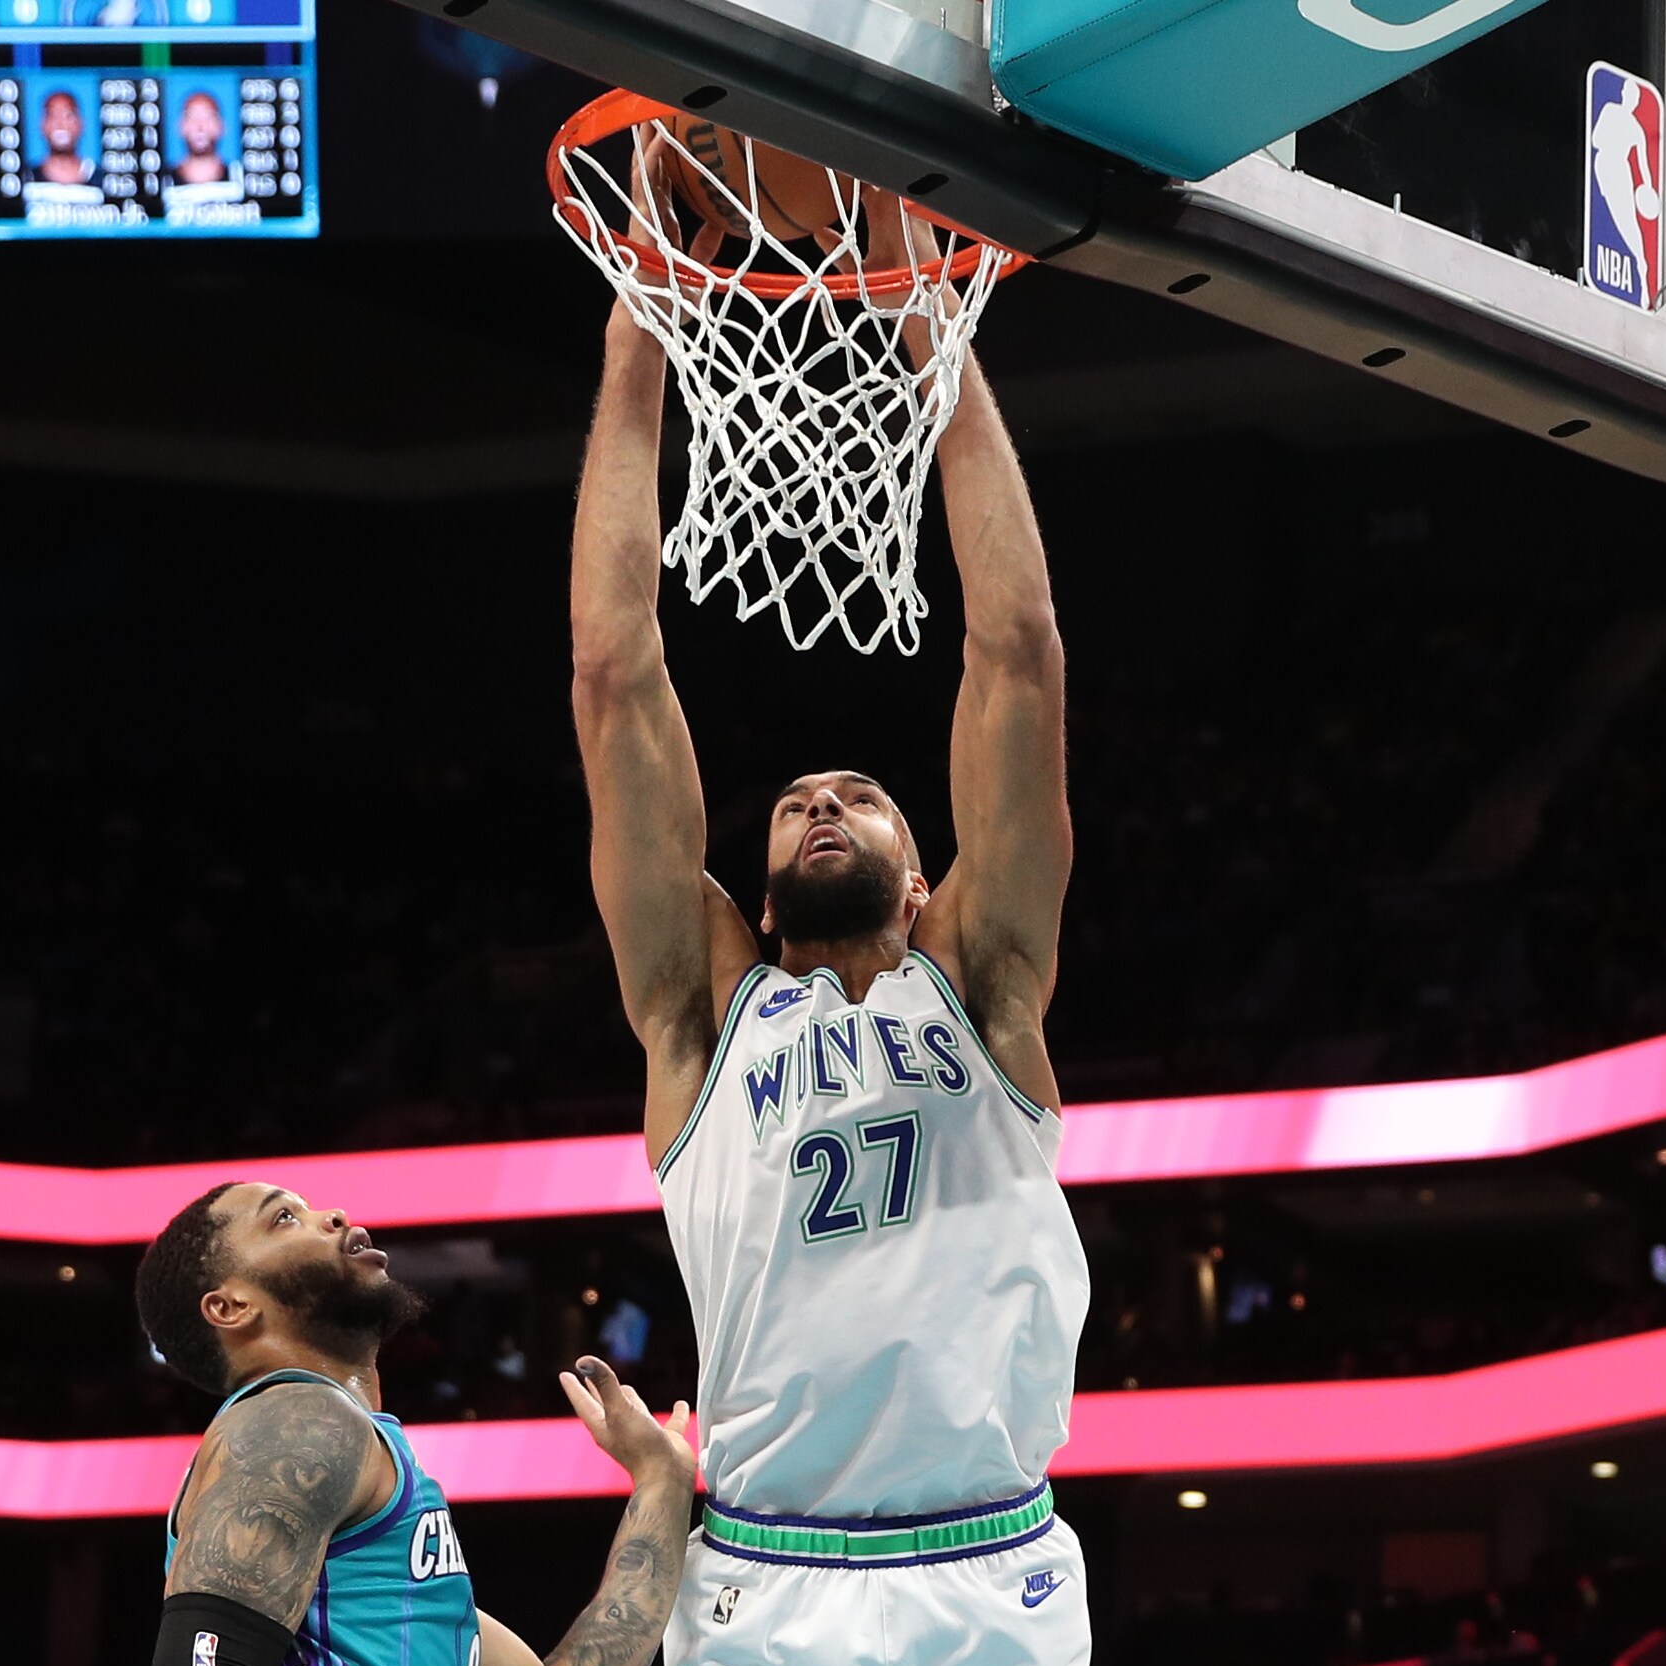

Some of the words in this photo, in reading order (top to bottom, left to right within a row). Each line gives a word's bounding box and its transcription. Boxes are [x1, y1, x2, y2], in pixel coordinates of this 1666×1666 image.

[1596, 244, 1634, 294] NBA
[741, 1007, 972, 1143] WOLVES
[789, 1109, 924, 1244] 27
